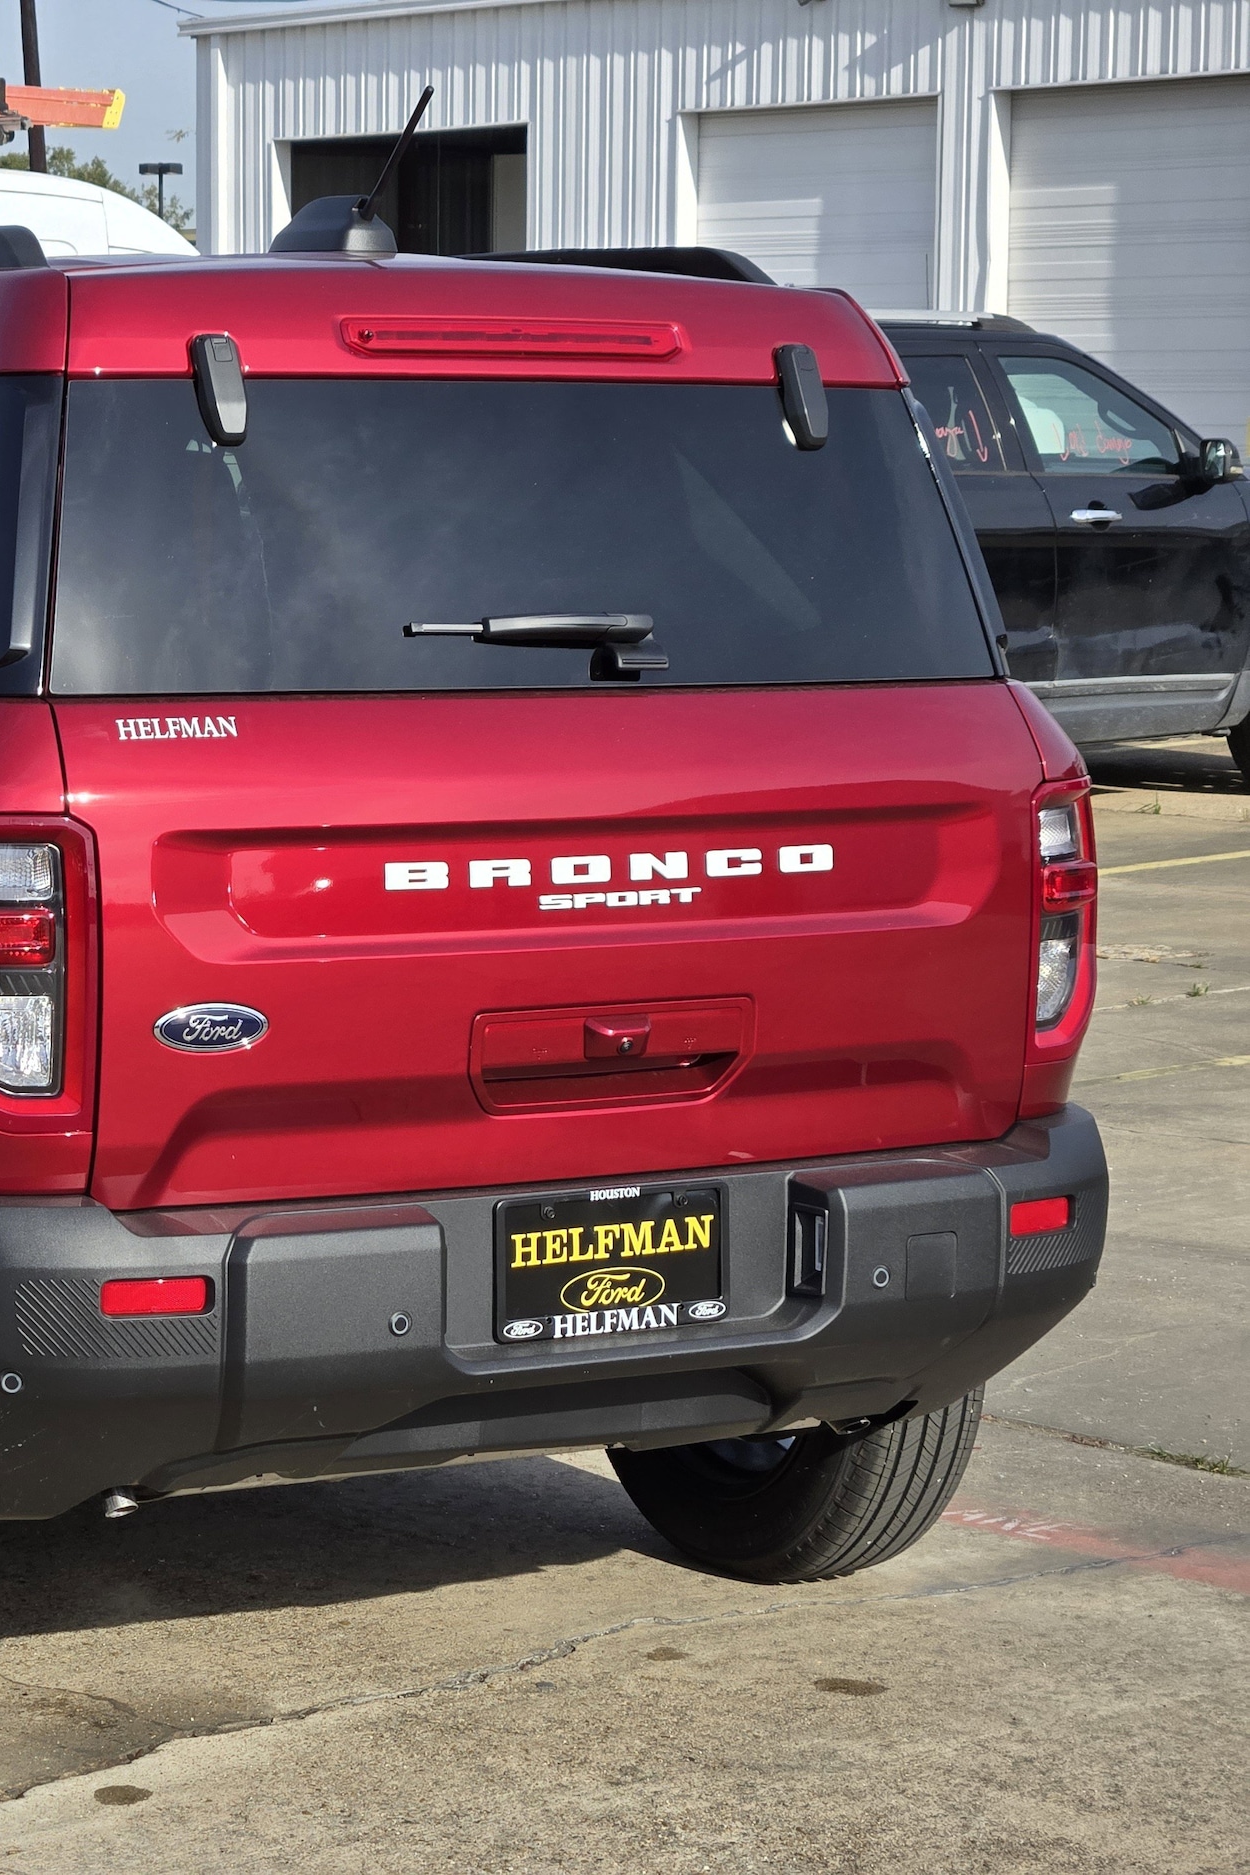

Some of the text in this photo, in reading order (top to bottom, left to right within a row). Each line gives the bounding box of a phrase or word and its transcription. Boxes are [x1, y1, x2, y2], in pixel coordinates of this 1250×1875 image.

[115, 716, 238, 740] HELFMAN
[383, 843, 835, 891] BRONCO
[538, 886, 702, 910] SPORT
[182, 1014, 244, 1042] Ford
[589, 1186, 641, 1201] HOUSTON
[510, 1214, 715, 1268] HELFMAN
[580, 1272, 647, 1307] Ford
[509, 1303, 719, 1338] Ford HELFMAN Ford
